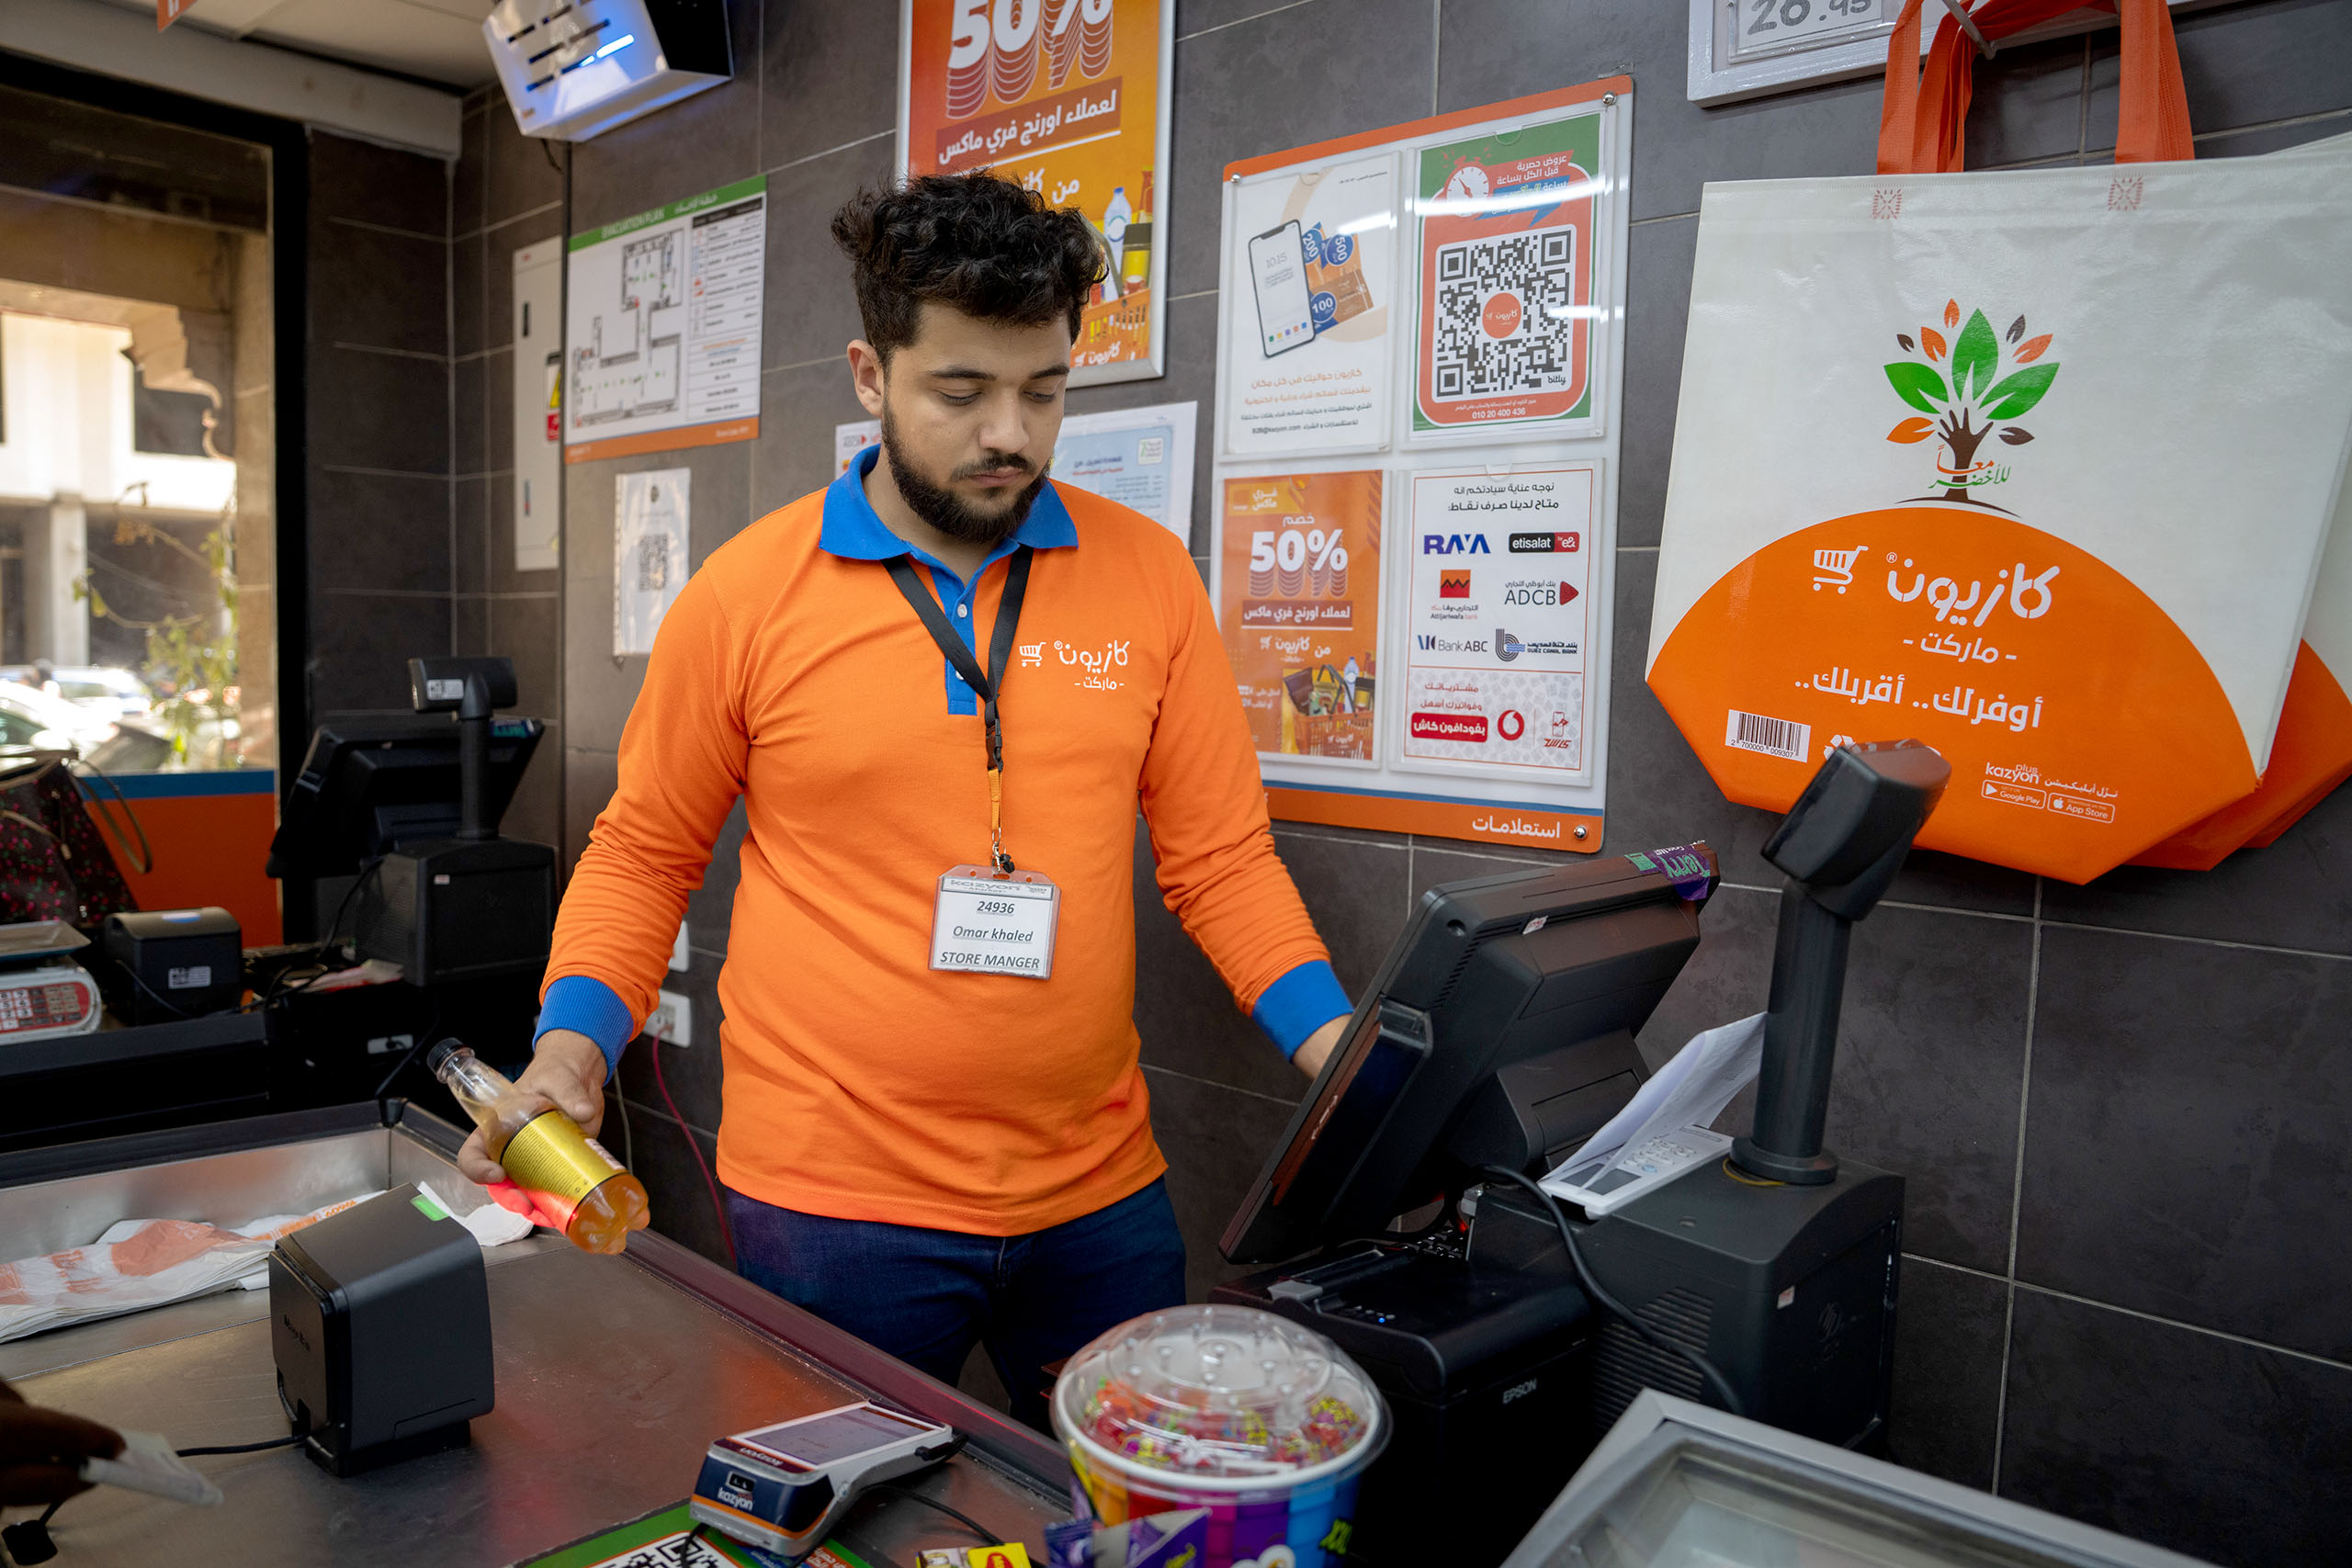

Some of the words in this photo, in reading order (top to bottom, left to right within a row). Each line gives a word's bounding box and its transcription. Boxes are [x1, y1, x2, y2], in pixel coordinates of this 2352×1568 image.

[1065, 89, 1117, 124] لعملاء
[1020, 105, 1062, 147] اورنج
[986, 119, 1018, 154] فري
[938, 130, 983, 165] ماكس
[1517, 161, 1541, 171] حصرية
[1544, 155, 1566, 166] عروض
[1524, 169, 1542, 181] الكل
[1544, 166, 1559, 177] قبل
[1497, 175, 1521, 185] بساعة
[1052, 179, 1080, 204] من
[1302, 233, 1319, 257] 200
[1335, 237, 1348, 261] 500
[1312, 298, 1333, 313] 100
[1547, 375, 1566, 386] bitly
[1465, 485, 1506, 496] سيادتكم
[1508, 483, 1530, 494] عناية
[1532, 482, 1555, 493] نوجه
[1510, 499, 1533, 511] لدينا
[1283, 513, 1315, 527] خصم
[1423, 534, 1491, 555] RAYA
[1512, 536, 1552, 549] etisalat
[1250, 529, 1348, 573] 50%
[1504, 589, 1556, 605] ADCB
[1887, 558, 2061, 628] كازيون
[1244, 605, 1272, 621] ماكس
[1273, 606, 1293, 622] فري
[1294, 605, 1319, 623] اورنج
[1321, 605, 1351, 619] لعملاء
[1274, 636, 1310, 654] كازيون
[1315, 646, 1331, 659] من
[1059, 640, 1130, 673] كازيون
[1413, 718, 1439, 733] كاش
[1730, 739, 1736, 747] 2
[1741, 741, 1764, 752] 700000
[1770, 748, 1794, 759] 009307
[1985, 761, 2041, 784] kazyon
[2015, 763, 2039, 774] plus
[2000, 791, 2025, 803] Google
[2025, 795, 2041, 806] Play
[2065, 804, 2084, 815] App
[2086, 808, 2109, 819] Store
[1472, 815, 1561, 839] استعلامات
[978, 901, 1014, 914] 24936
[953, 926, 989, 938] Omar
[991, 928, 1033, 942] khaled
[941, 952, 981, 964] STORE
[984, 954, 1040, 969] MANGER
[1503, 1378, 1537, 1404] EPSON
[718, 1487, 754, 1512] kazyon
